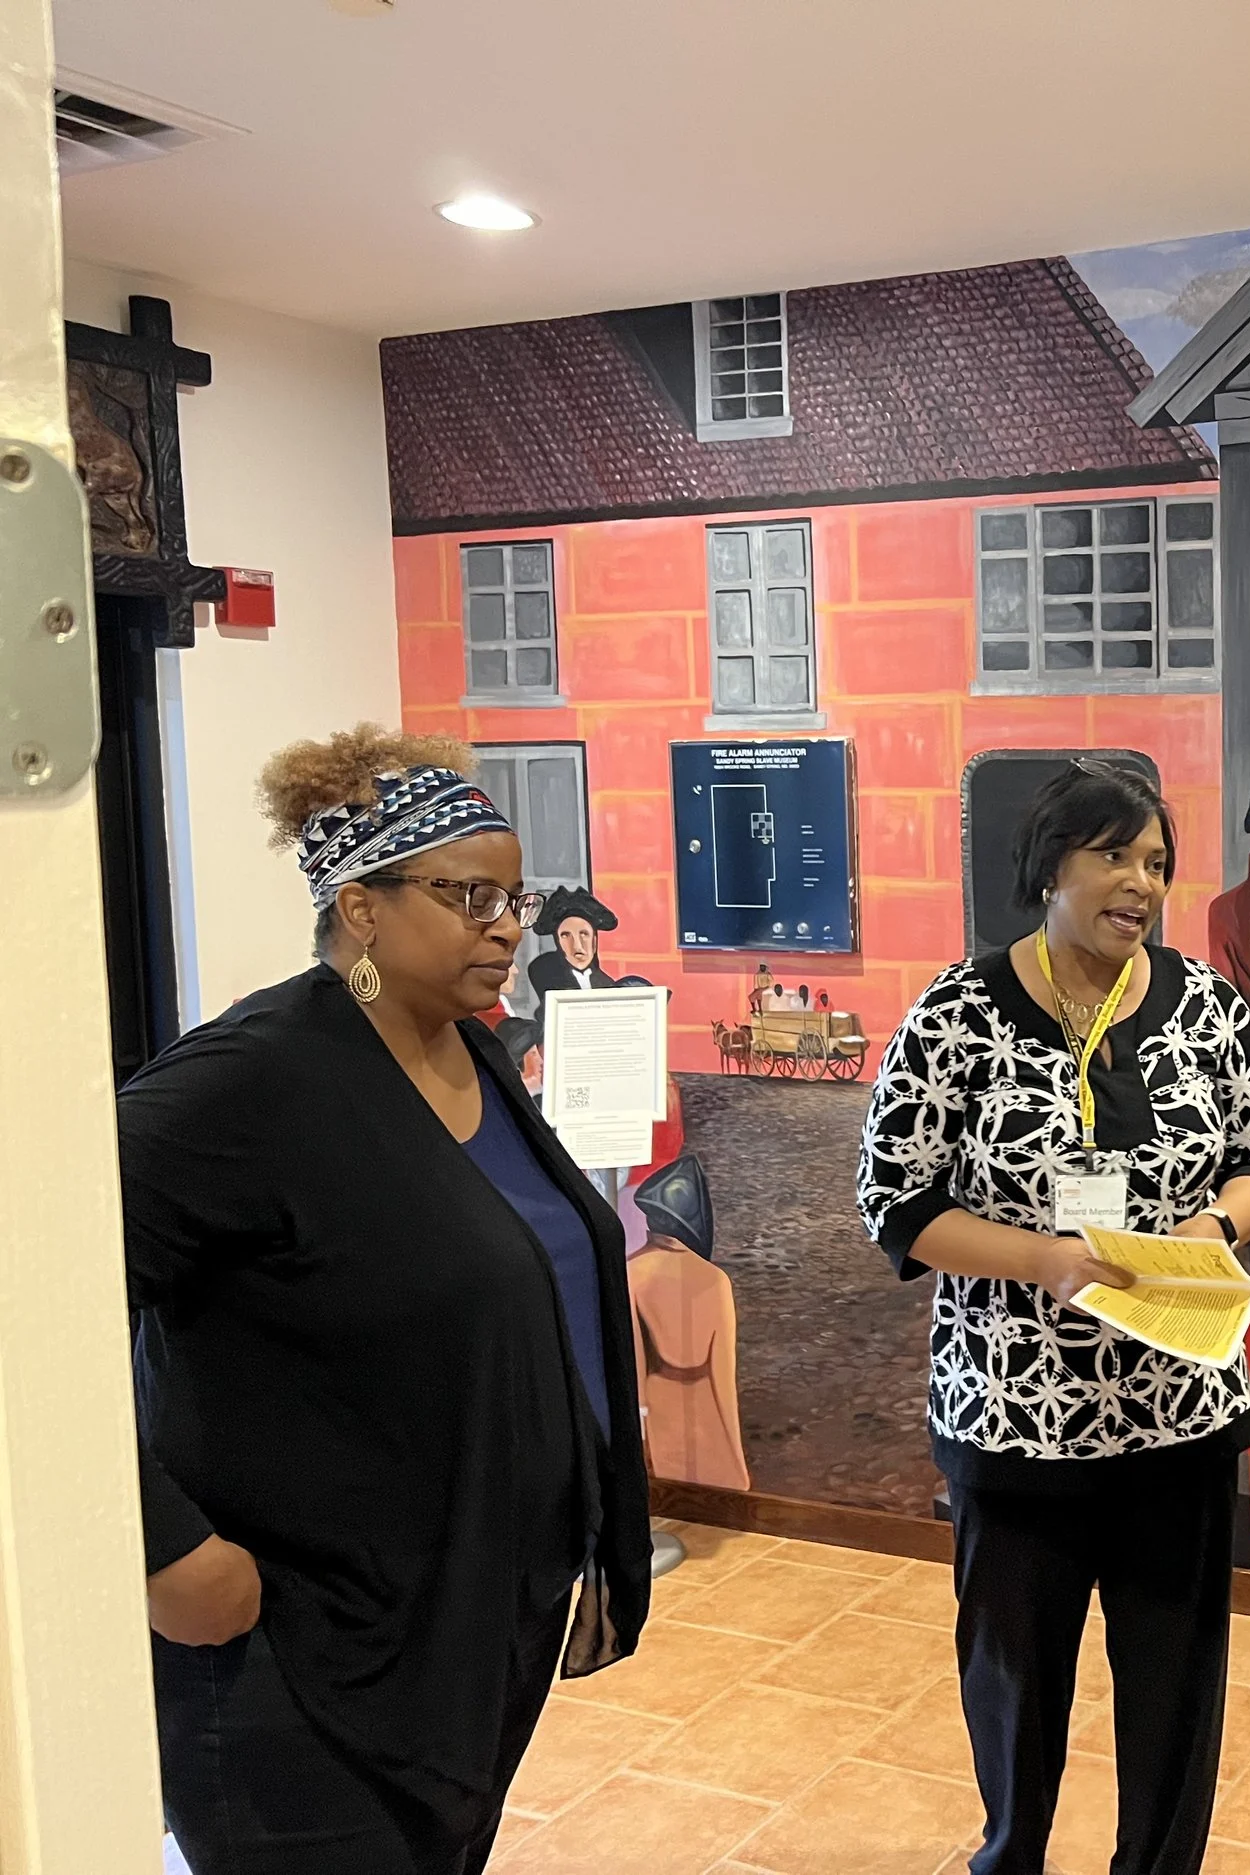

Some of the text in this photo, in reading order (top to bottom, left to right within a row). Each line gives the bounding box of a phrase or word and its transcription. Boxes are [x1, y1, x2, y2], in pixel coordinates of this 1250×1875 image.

[711, 748, 806, 757] FIRE ALARM ANNUNCIATOR
[1063, 1208, 1123, 1216] Board Member
